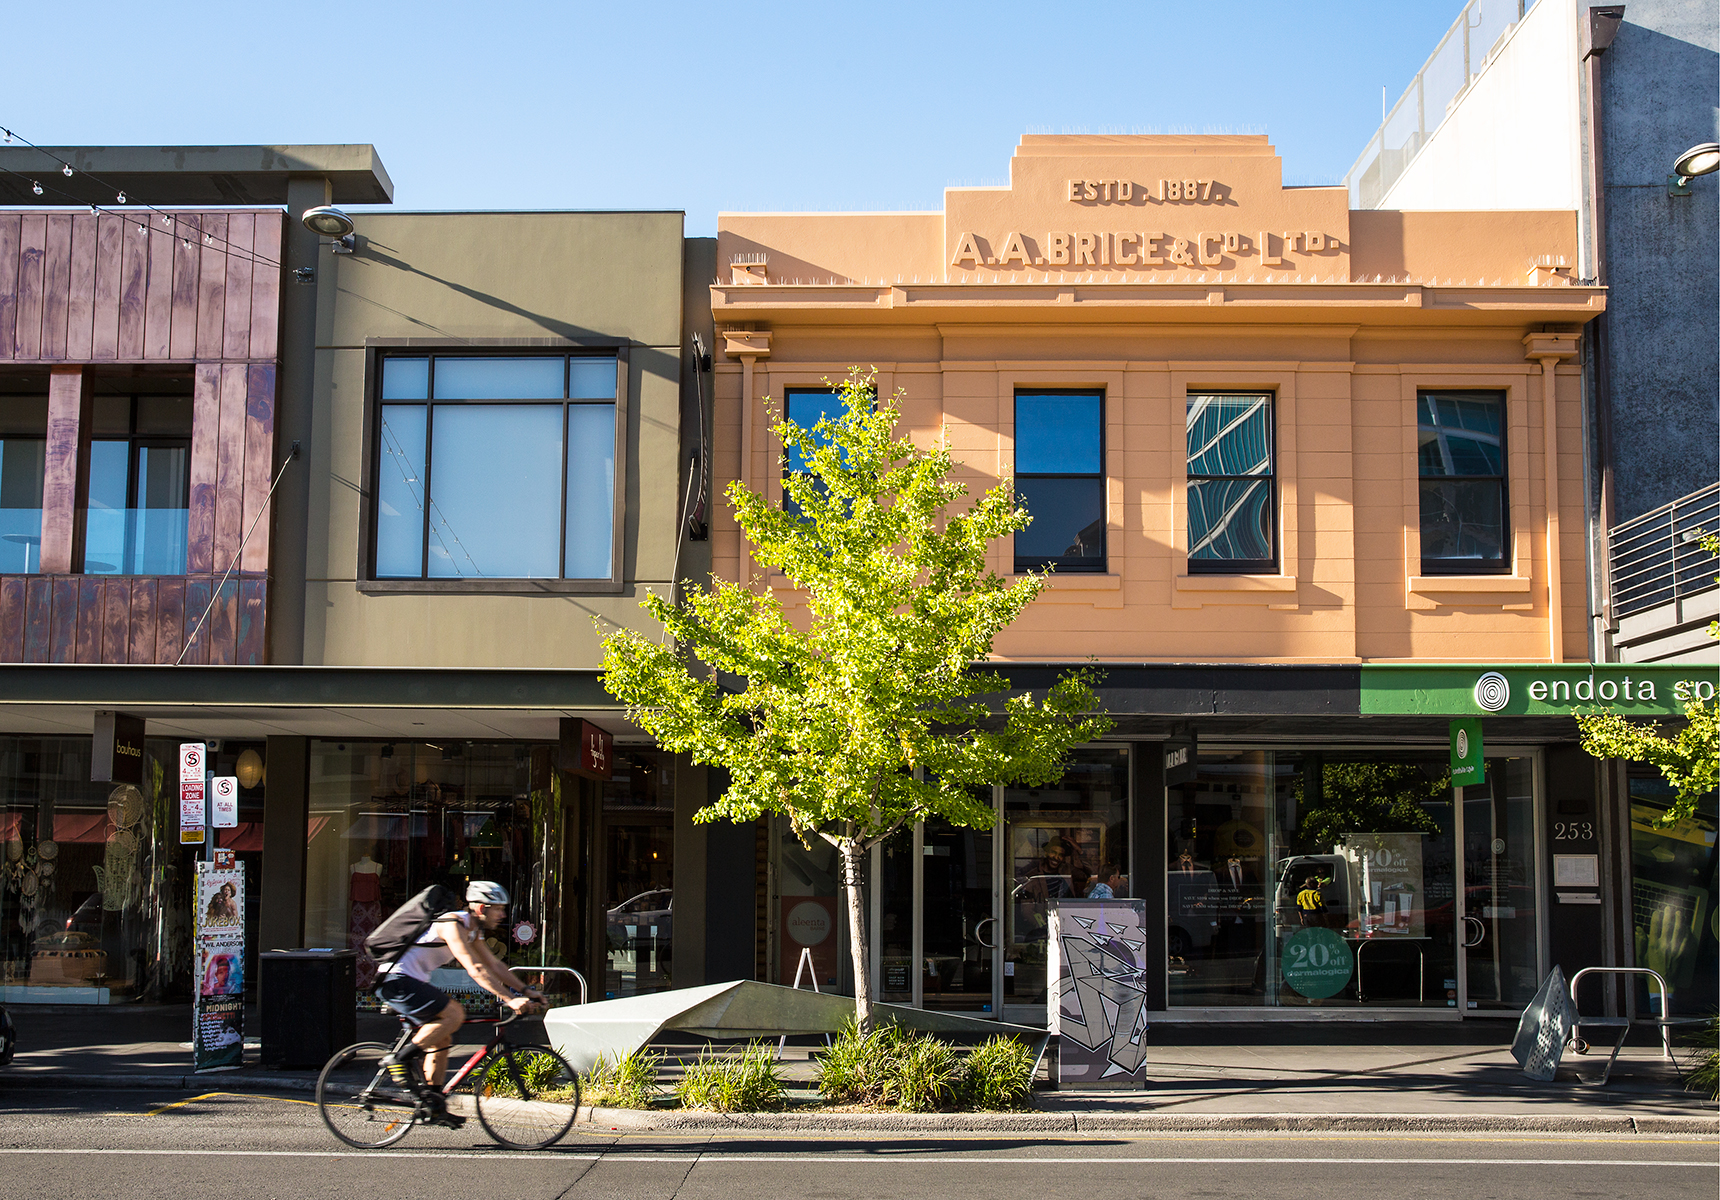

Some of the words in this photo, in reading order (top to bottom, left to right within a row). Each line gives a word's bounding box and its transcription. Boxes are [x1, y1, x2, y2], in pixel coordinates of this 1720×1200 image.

[1528, 675, 1657, 701] endota
[116, 739, 141, 758] bauhaus
[182, 784, 203, 792] LOADING
[1554, 822, 1594, 840] 253
[1393, 858, 1408, 867] off
[202, 916, 241, 928] JUKEBOX
[792, 917, 825, 926] aleenta
[216, 940, 243, 948] ANDERSON
[1330, 956, 1347, 966] off
[1287, 968, 1350, 977] dermalogica
[206, 1002, 242, 1013] MIDNIGHT
